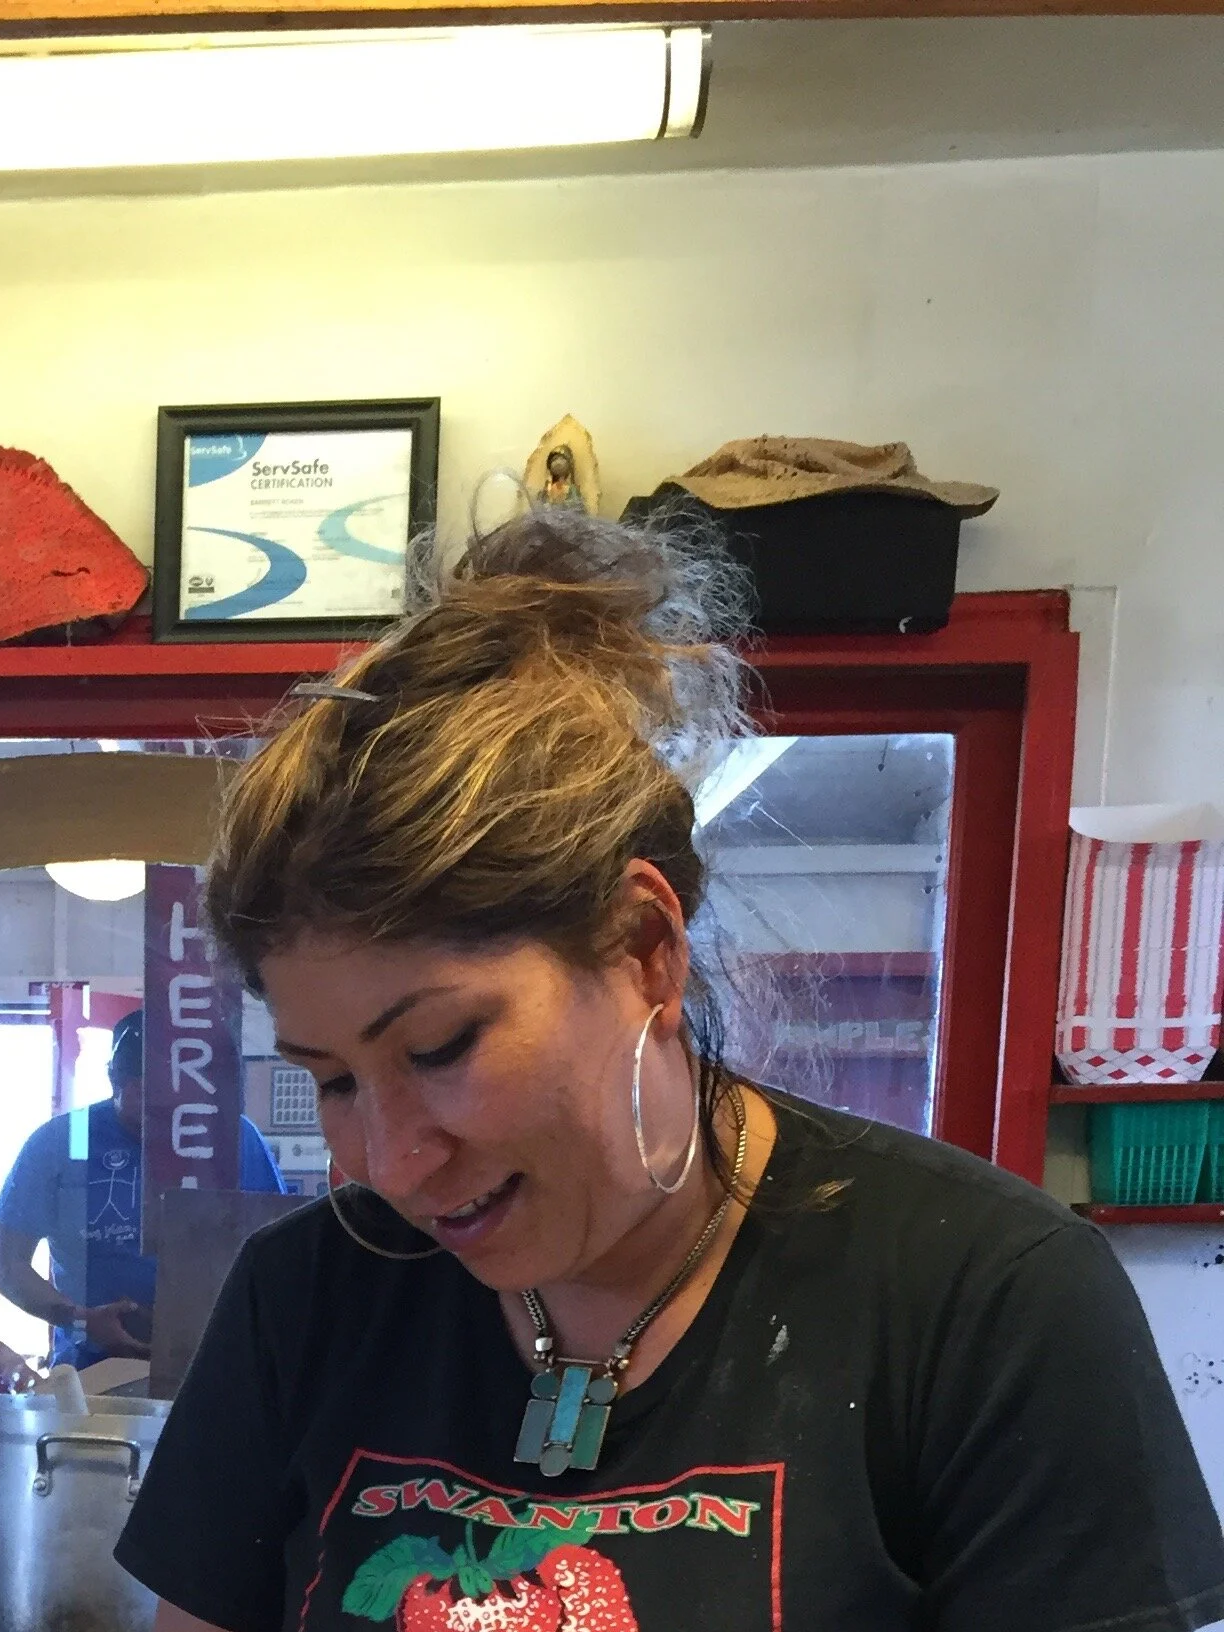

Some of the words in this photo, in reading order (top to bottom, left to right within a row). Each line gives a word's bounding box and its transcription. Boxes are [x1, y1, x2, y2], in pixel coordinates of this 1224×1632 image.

[251, 458, 330, 477] ServSafe
[250, 477, 333, 490] CERTIFICATION
[351, 1477, 762, 1538] SWANTON
